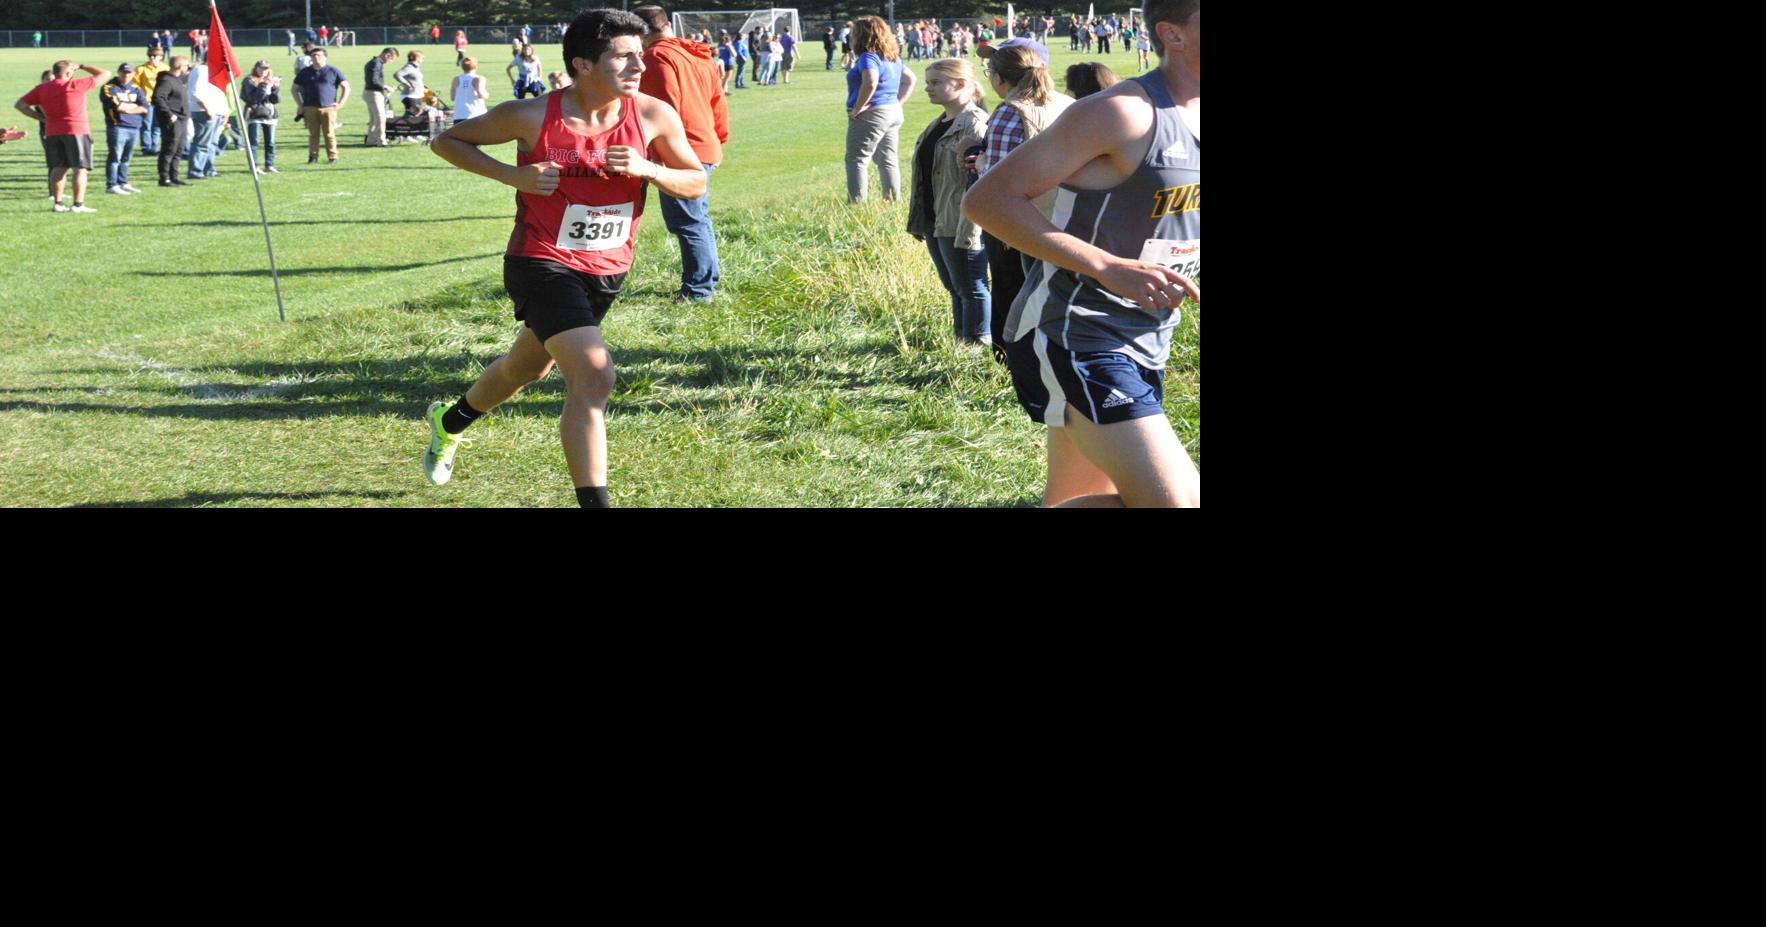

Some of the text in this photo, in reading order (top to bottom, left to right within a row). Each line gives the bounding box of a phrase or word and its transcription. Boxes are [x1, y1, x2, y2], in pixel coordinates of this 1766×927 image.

[545, 147, 580, 164] BIG
[568, 220, 624, 240] 3391
[1102, 397, 1134, 408] adidas
